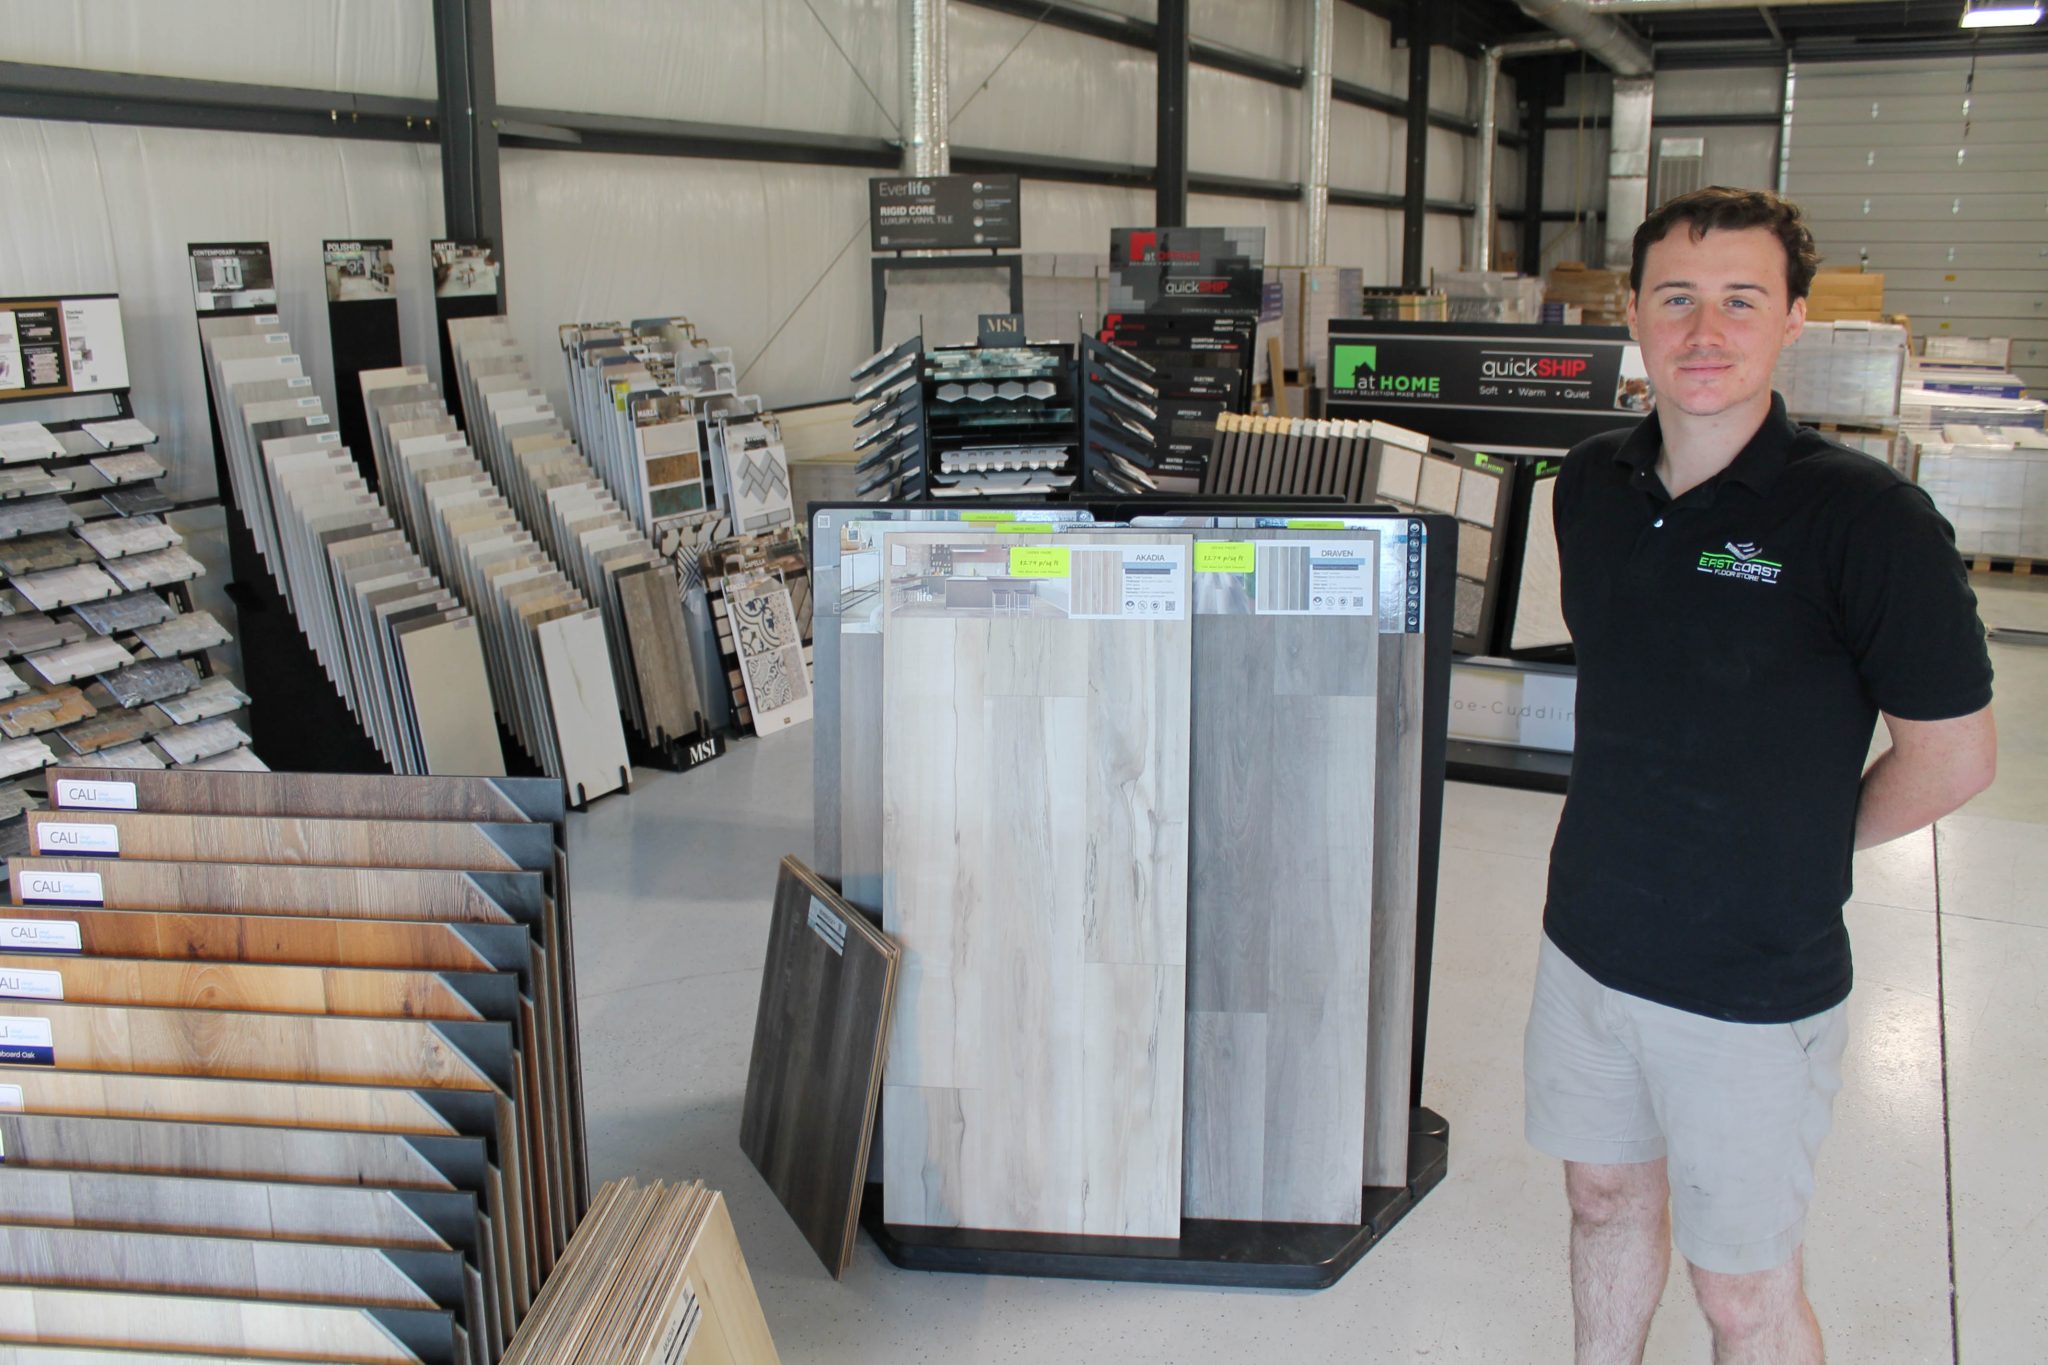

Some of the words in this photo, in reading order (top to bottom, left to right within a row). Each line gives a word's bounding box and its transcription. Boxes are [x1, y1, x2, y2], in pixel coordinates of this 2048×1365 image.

[879, 182, 930, 196] Everlife
[880, 206, 907, 215] RIGID
[909, 205, 935, 215] CORE
[880, 217, 910, 225] LUXURY
[937, 216, 953, 224] TILE
[327, 242, 361, 251] POLISHED
[434, 242, 456, 250] MATTE
[193, 249, 236, 257] CONTEMPORARY
[1166, 280, 1229, 294] quickSHIP
[987, 318, 1017, 333] MSI
[1482, 357, 1586, 378] quickSHIP
[1357, 375, 1376, 389] at
[1380, 375, 1440, 391] HOME
[1479, 386, 1498, 395] Soft
[1518, 387, 1546, 397] Warm
[1564, 388, 1590, 399] Quiet
[1136, 554, 1165, 562] AKADIA
[1321, 549, 1353, 557] DRAVEN
[1714, 568, 1736, 577] FLOOR
[1736, 572, 1759, 582] STORE
[689, 738, 716, 765] MSI
[69, 788, 97, 801] CALI
[50, 831, 78, 844] CALI
[32, 880, 61, 893] CALI
[11, 926, 38, 939] CALI
[21, 1051, 36, 1059] Oak
